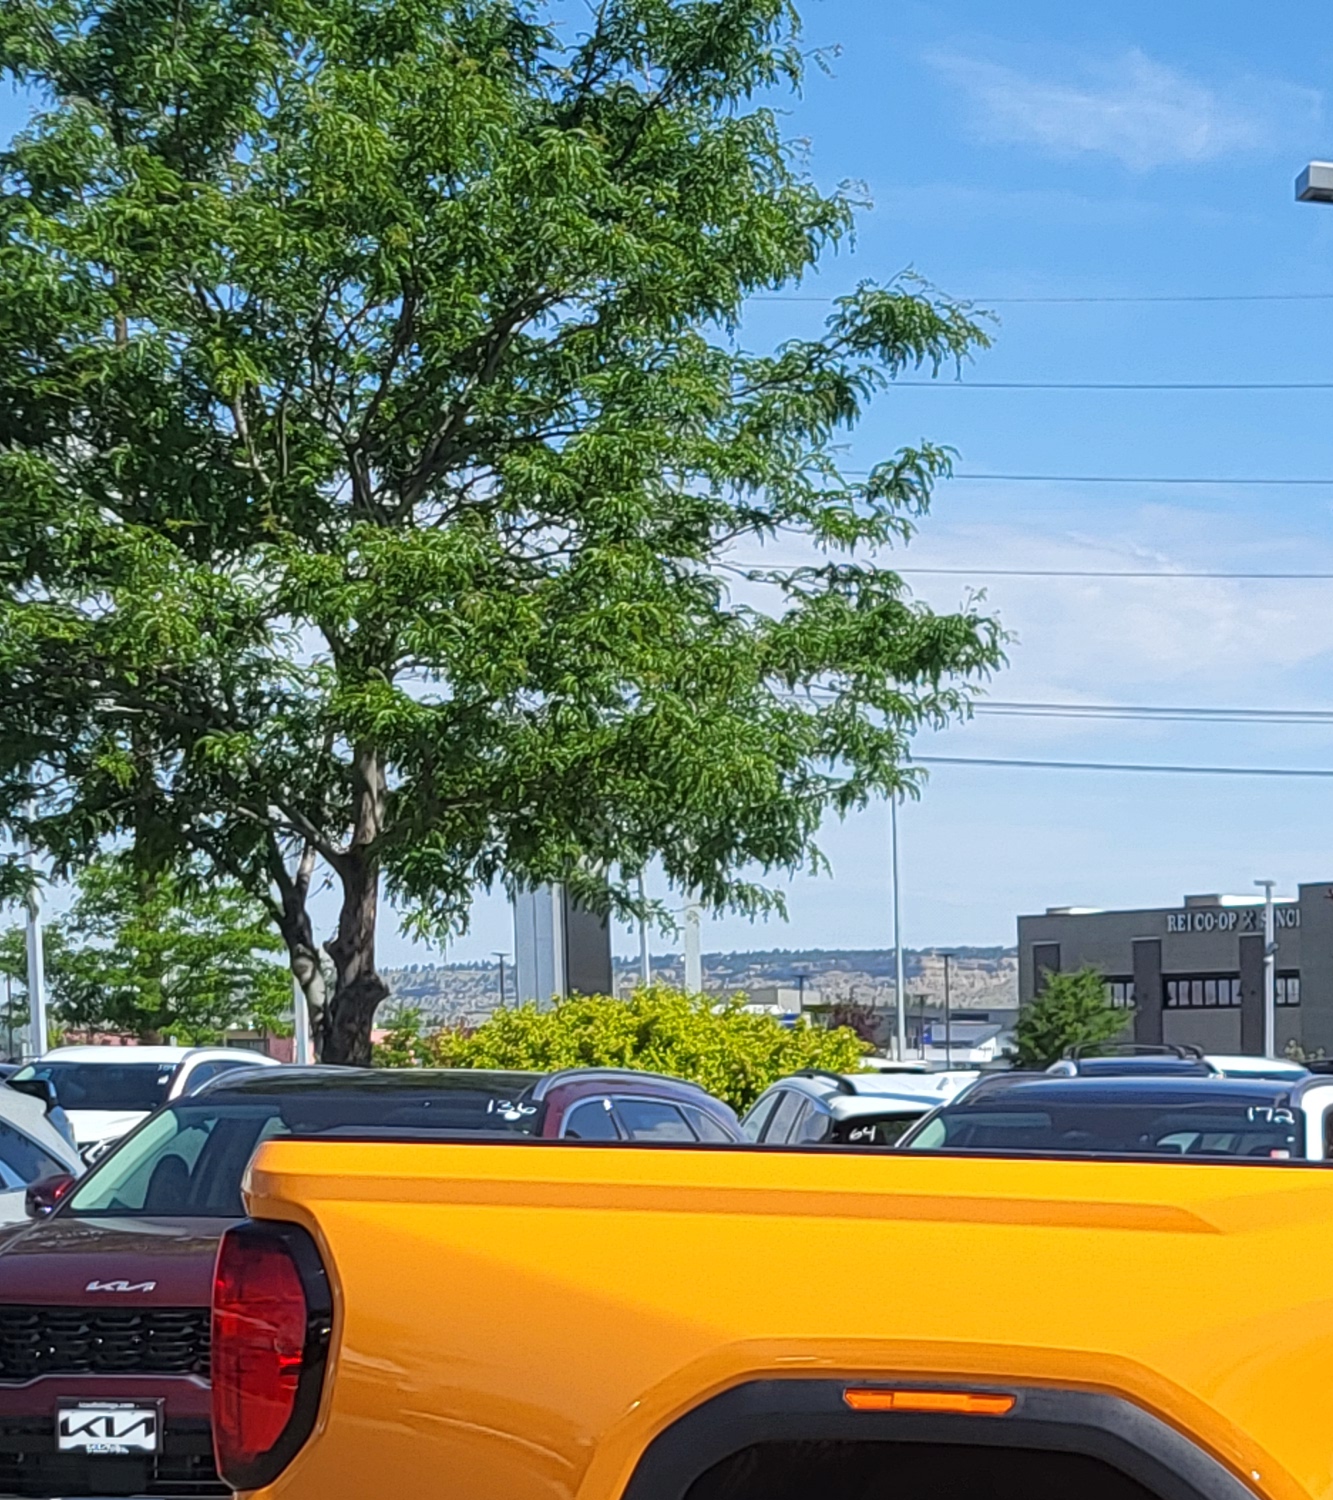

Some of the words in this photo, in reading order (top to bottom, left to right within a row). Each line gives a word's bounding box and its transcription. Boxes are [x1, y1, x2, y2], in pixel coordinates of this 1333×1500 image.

[1167, 912, 1191, 932] REI
[487, 1099, 537, 1116] 136
[1247, 1106, 1295, 1125] 172
[849, 1125, 876, 1142] 64
[86, 1280, 157, 1292] KIA
[60, 1415, 155, 1438] KIA
